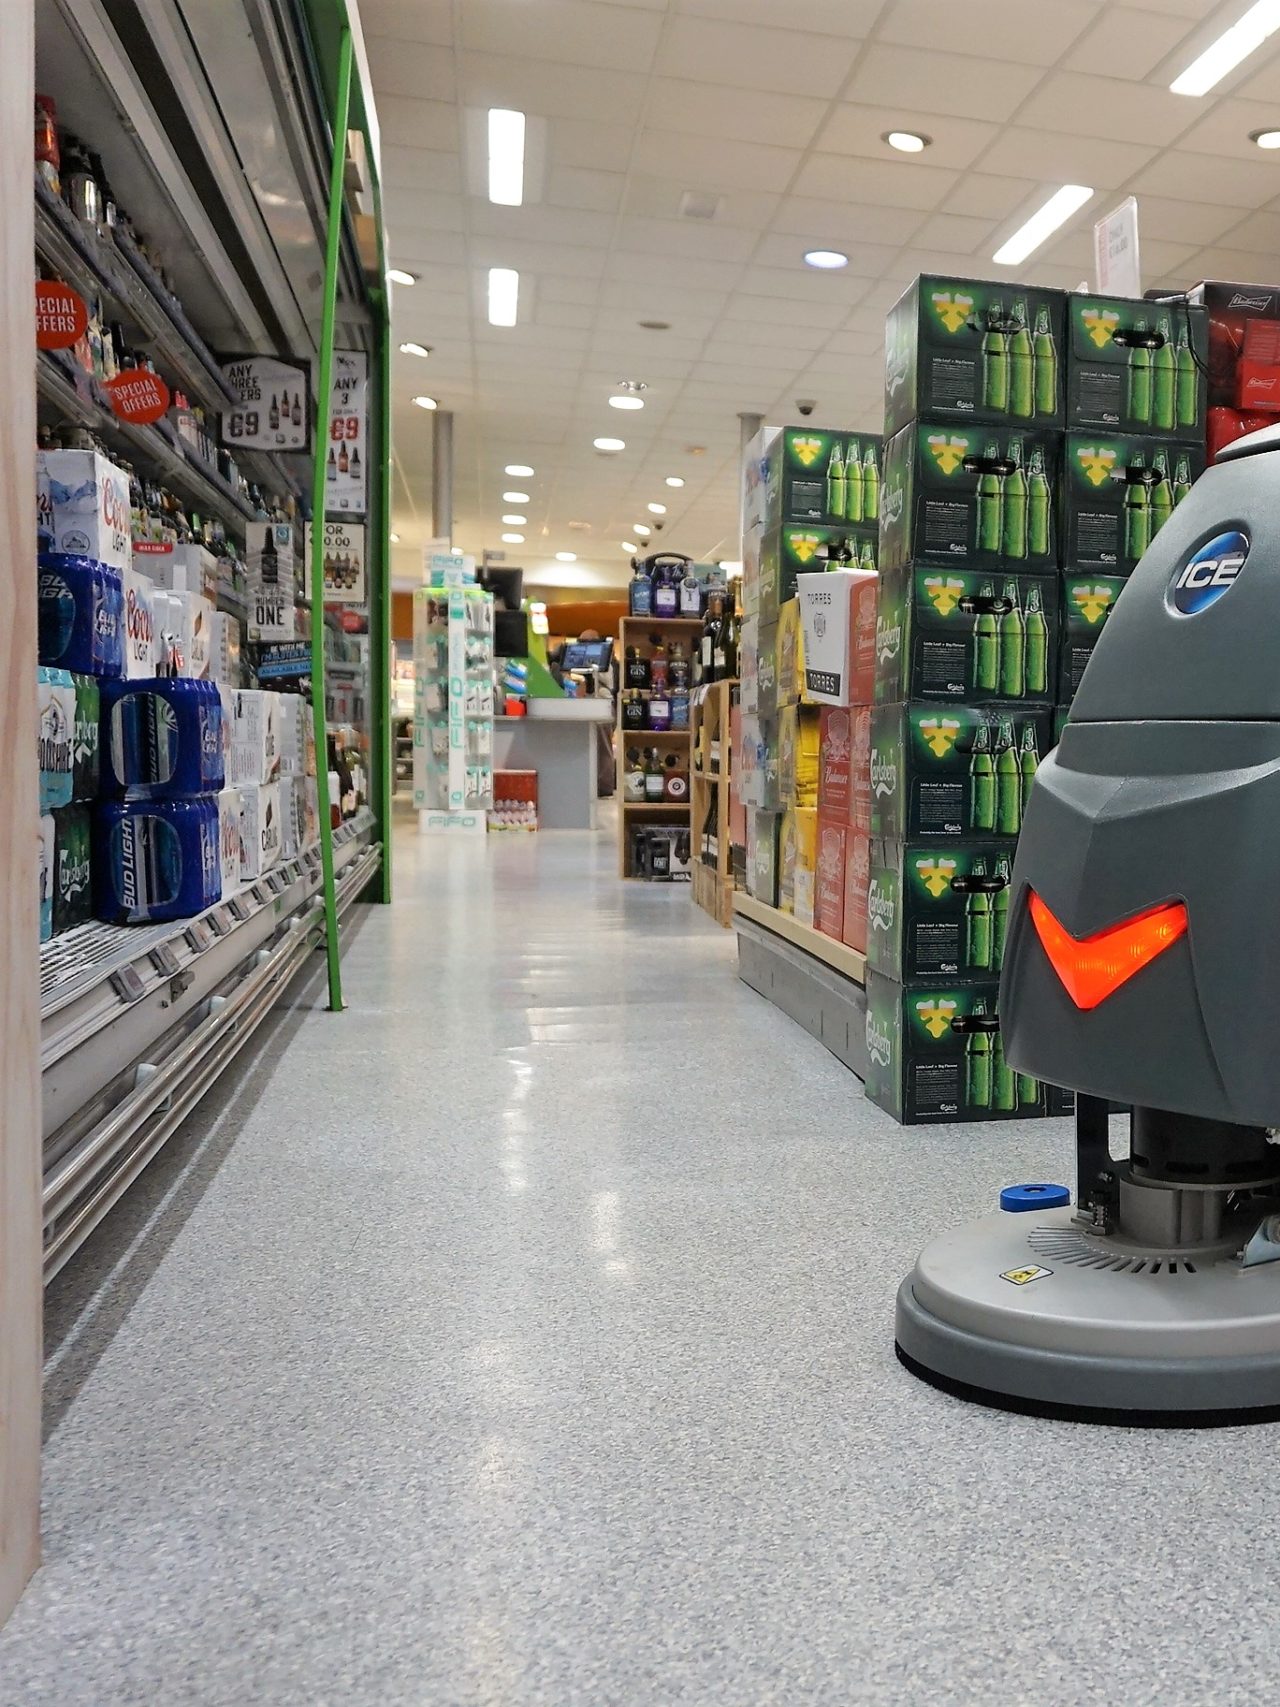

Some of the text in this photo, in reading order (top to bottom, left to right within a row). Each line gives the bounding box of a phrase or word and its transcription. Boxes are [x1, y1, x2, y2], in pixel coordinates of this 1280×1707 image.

[36, 297, 77, 314] ECIAL
[36, 315, 76, 332] FFERS
[229, 364, 252, 378] ANY
[114, 378, 158, 400] SPECIAL
[240, 388, 261, 401] ERS
[334, 379, 359, 391] ANY
[122, 391, 162, 413] OFFERS
[228, 411, 259, 438] €9
[330, 416, 359, 441] €9
[1176, 558, 1245, 589] ICE
[256, 606, 285, 626] ONE
[810, 673, 835, 693] TORRES
[870, 748, 896, 799] Carlsberg
[121, 818, 136, 910] BUD LIGHT
[868, 879, 895, 931] Carlsberg
[866, 1009, 891, 1067] Carlsberg
